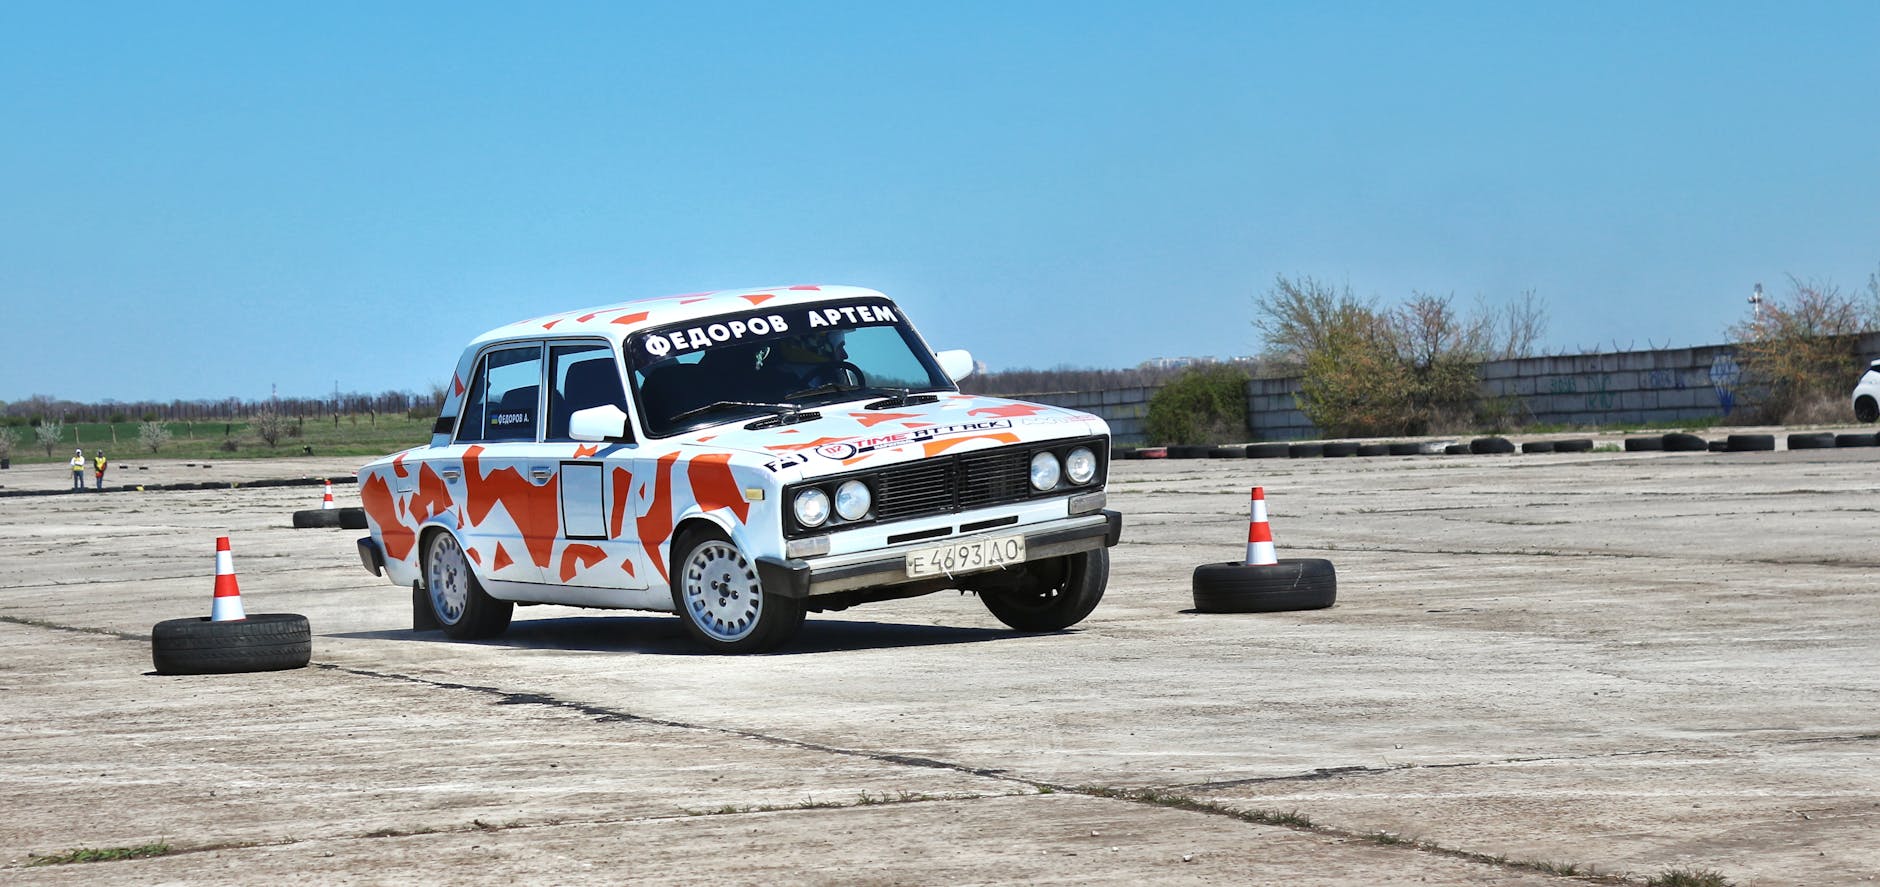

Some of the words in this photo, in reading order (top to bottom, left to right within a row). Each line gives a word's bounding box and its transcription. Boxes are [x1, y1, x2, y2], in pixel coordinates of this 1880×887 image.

[645, 314, 789, 357] ФЕДОРОВ
[808, 305, 898, 328] АРТЕМ
[498, 413, 522, 425] ФЕДОРОВ
[853, 432, 908, 448] TIME
[914, 420, 1006, 437] ATTACK
[931, 545, 982, 571] 4693
